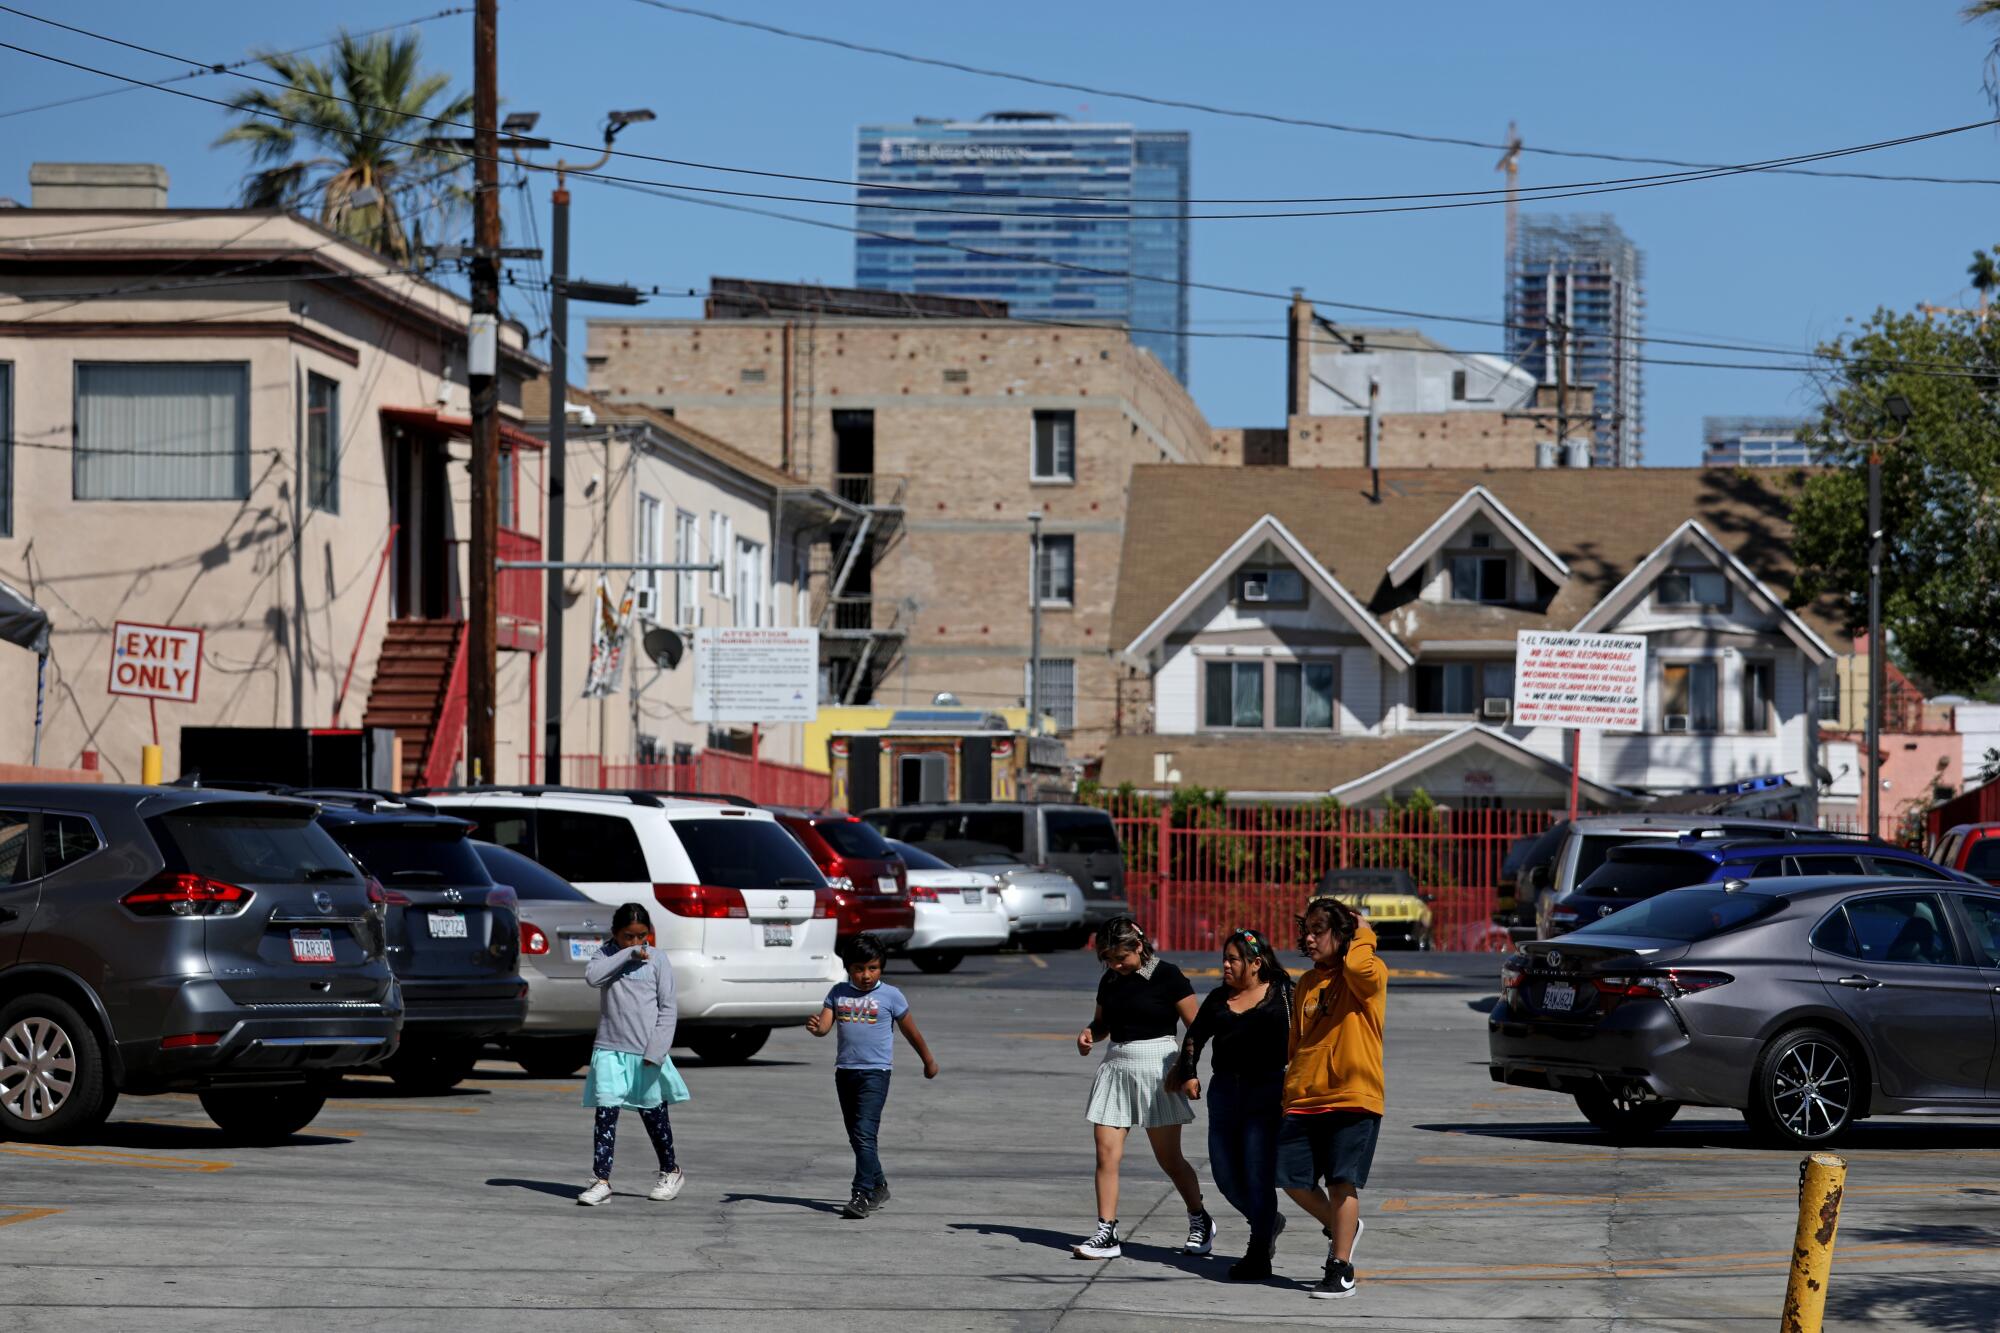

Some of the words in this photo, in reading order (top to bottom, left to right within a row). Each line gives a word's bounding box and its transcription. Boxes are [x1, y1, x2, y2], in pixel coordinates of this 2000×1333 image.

[126, 632, 187, 660] EXIT
[1539, 636, 1580, 646] TAURINO
[1602, 639, 1641, 649] GERENCIA
[117, 662, 189, 692] ONLY
[1579, 694, 1620, 702] RESPONSIBLE
[838, 996, 880, 1010] Levi's
